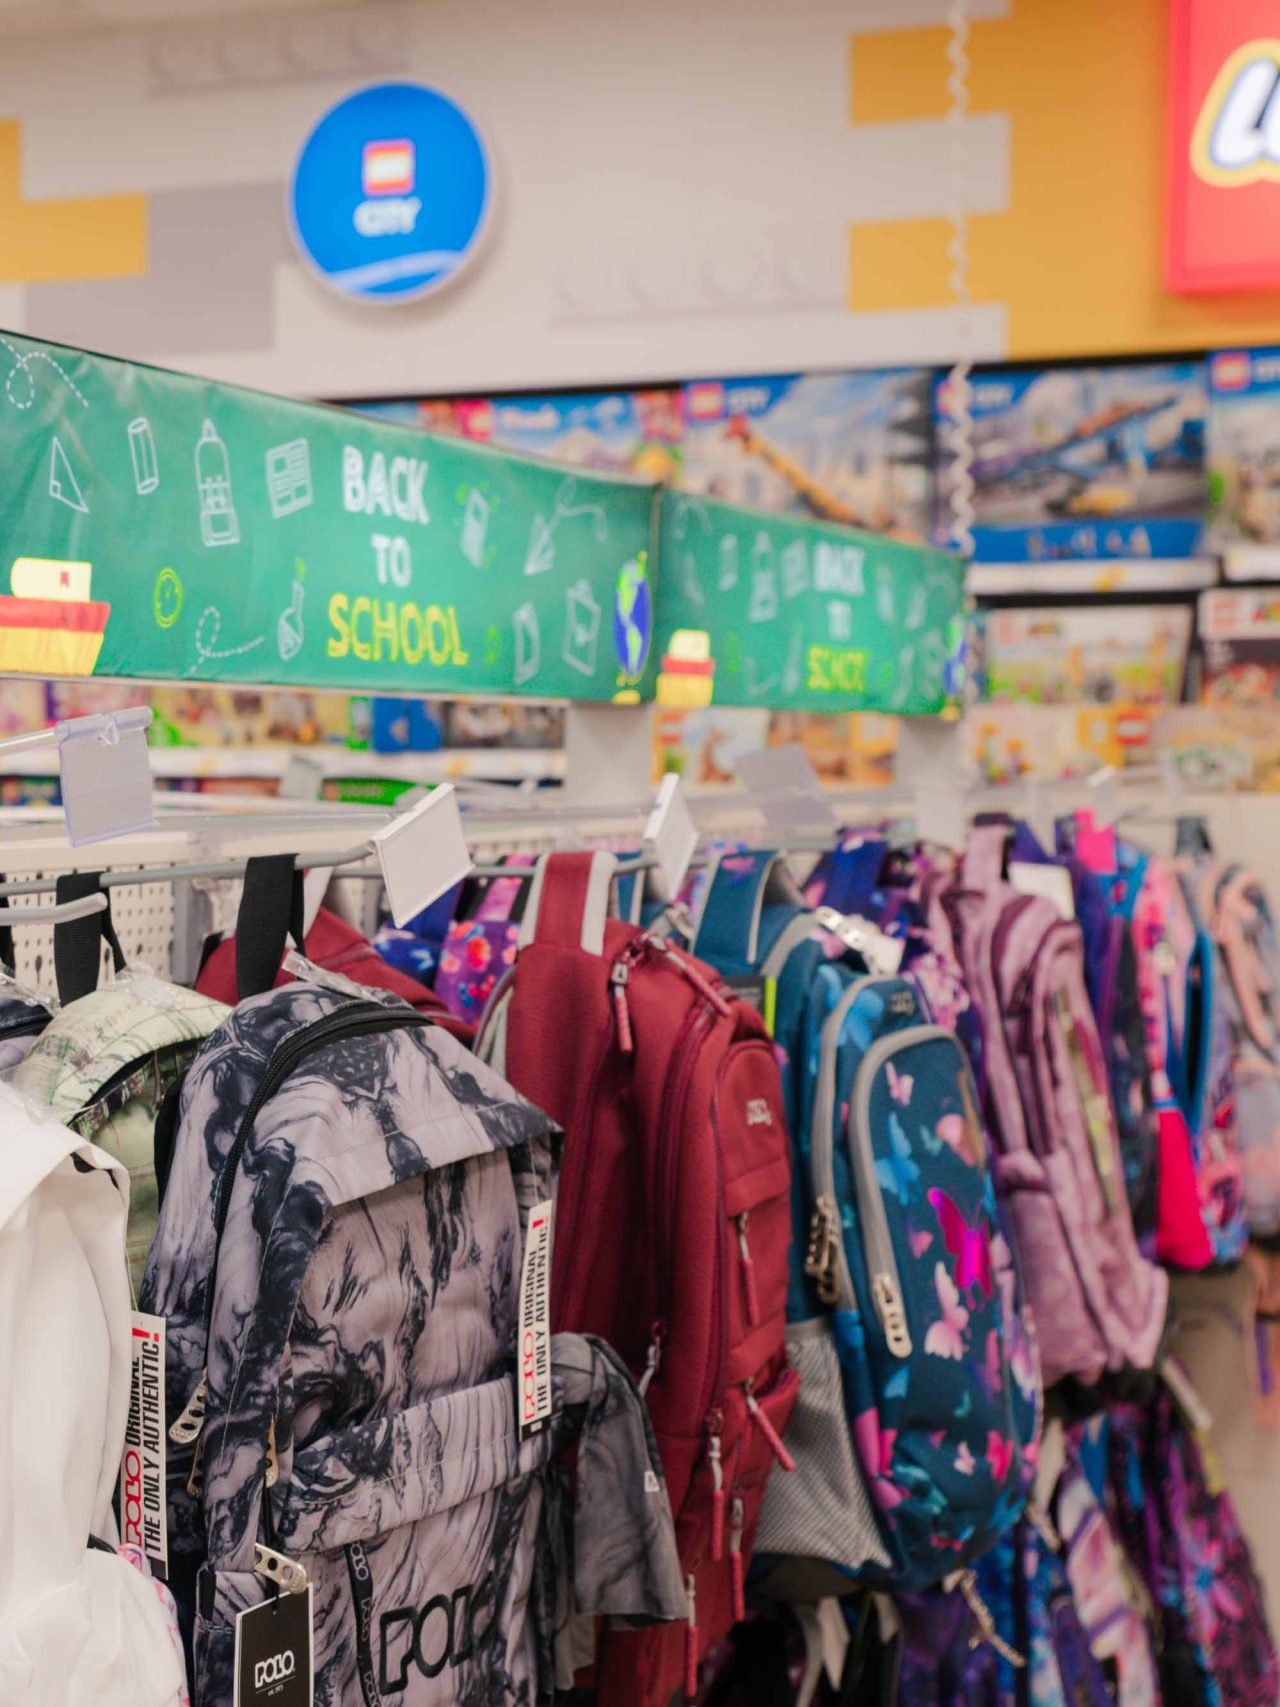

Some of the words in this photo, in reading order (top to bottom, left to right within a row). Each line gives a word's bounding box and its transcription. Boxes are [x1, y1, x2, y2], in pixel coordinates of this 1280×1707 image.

[342, 444, 430, 526] BACK
[371, 533, 412, 588] TO
[326, 592, 469, 667] SCHOOL
[524, 1249, 538, 1328] ORIGINAL
[535, 1330, 547, 1376] ONLY
[536, 1379, 548, 1413] THE
[125, 1450, 141, 1546] POLO
[143, 1456, 160, 1512] ONLY
[143, 1515, 161, 1553] THE
[350, 1541, 369, 1581] OLO
[379, 1571, 497, 1697] POLO
[255, 1650, 294, 1688] POLO
